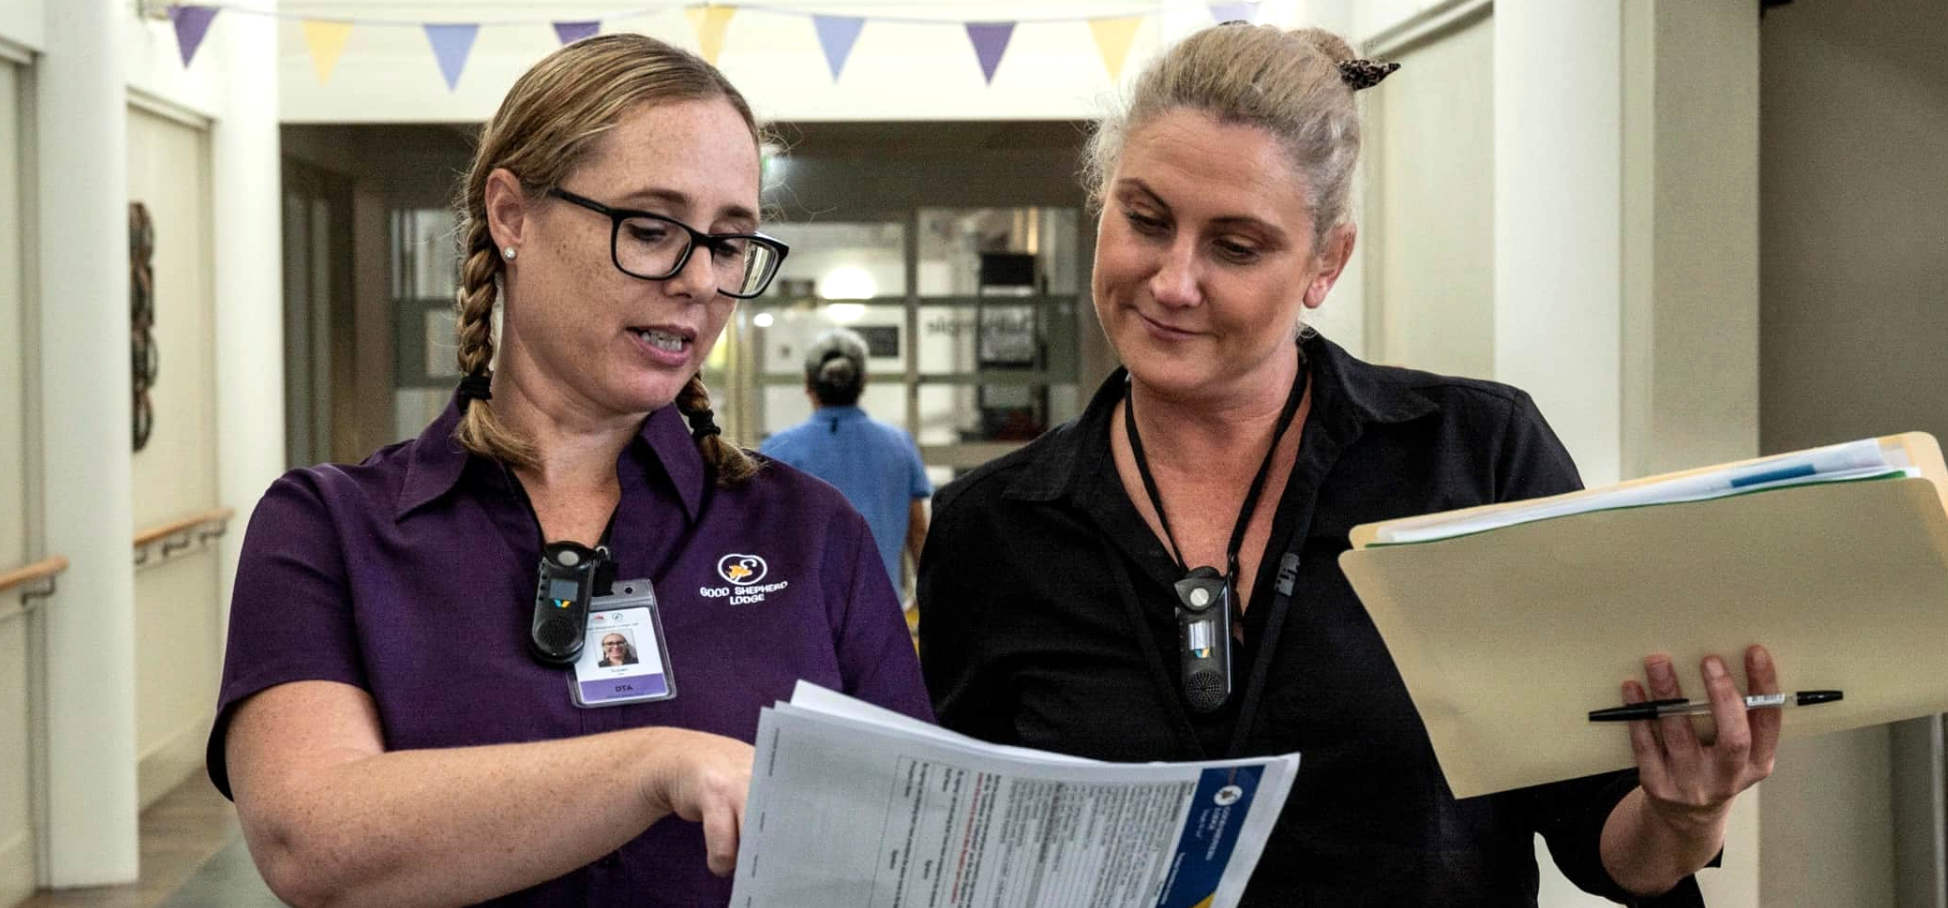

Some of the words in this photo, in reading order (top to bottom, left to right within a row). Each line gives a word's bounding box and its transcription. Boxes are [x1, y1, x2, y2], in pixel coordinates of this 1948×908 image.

[700, 587, 730, 597] GOOD
[734, 581, 788, 595] SHEPHERD
[729, 594, 765, 605] LODGE
[615, 684, 634, 693] DTA
